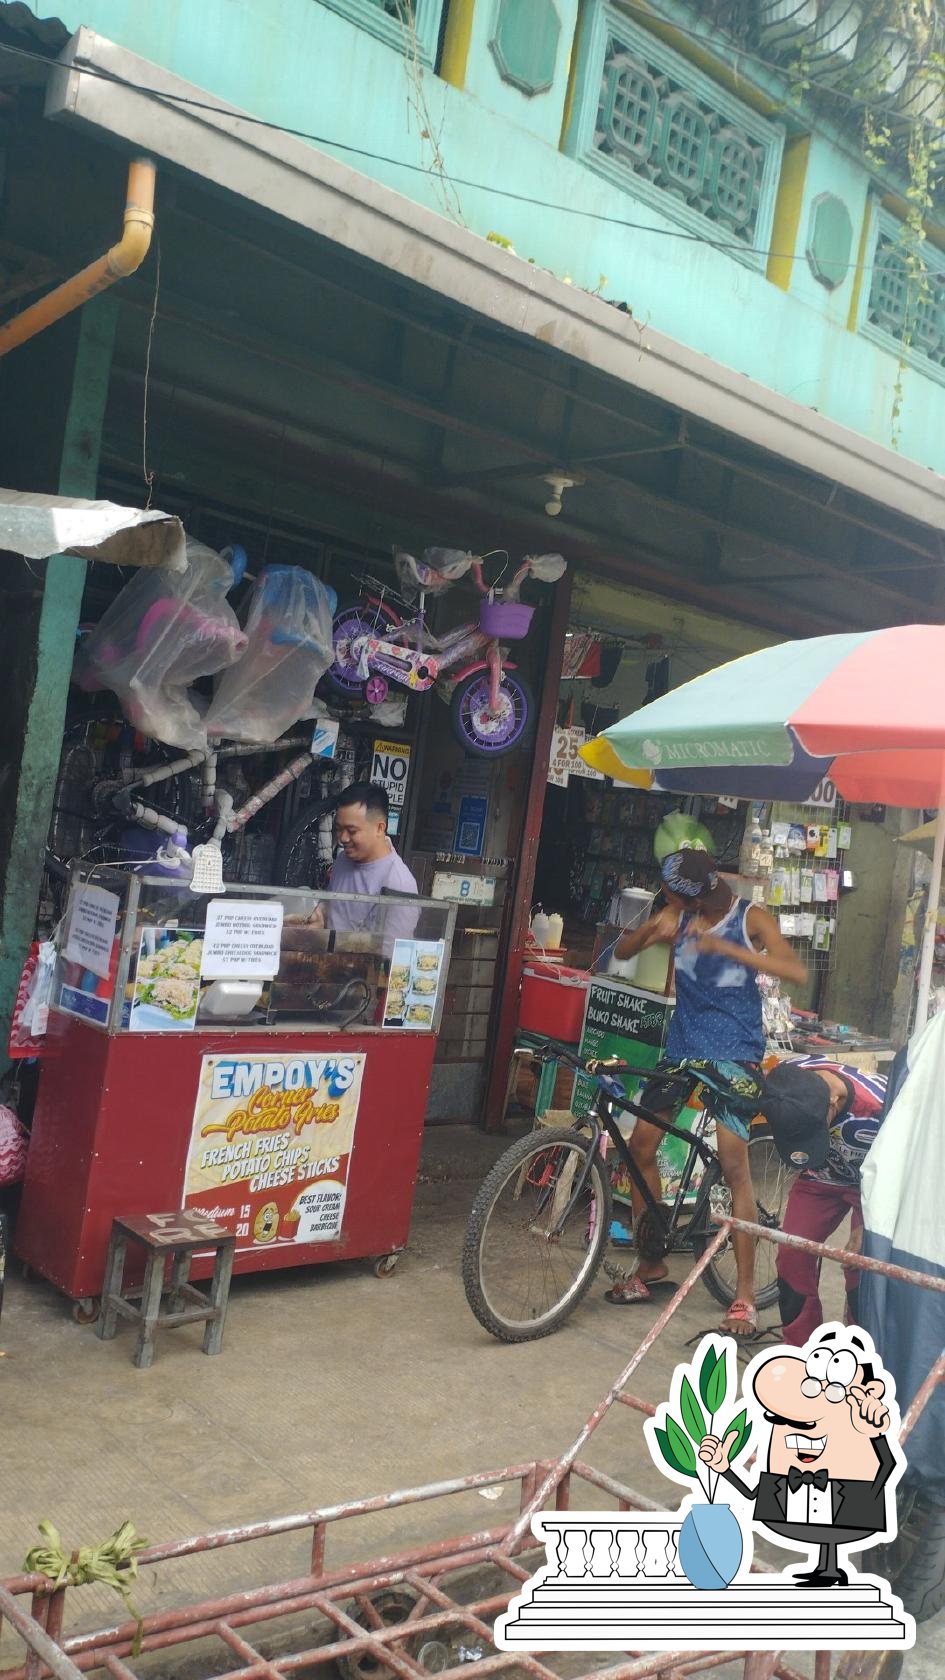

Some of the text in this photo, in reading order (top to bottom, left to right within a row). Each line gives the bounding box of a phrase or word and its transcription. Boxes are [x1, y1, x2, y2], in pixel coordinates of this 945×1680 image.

[384, 745, 410, 755] WARNING
[557, 736, 579, 759] 25
[664, 739, 770, 760] MICROMATIC
[373, 754, 407, 781] NO
[591, 985, 648, 1014] FRUIT SHAKE
[587, 1006, 609, 1024] BUKO
[610, 1013, 640, 1033] SHAKE
[211, 1058, 356, 1099] EMPOY'S
[201, 1106, 292, 1142] Potato
[200, 1132, 290, 1169] FRENCH FRIES
[221, 1145, 311, 1182] POTATO CHIPS
[249, 1156, 340, 1193] CHEESE STICKS
[240, 1204, 251, 1219] 15
[299, 1194, 316, 1205] BEST
[305, 1203, 341, 1214] SOUR CREAM
[320, 1212, 339, 1221] CHEESE
[235, 1223, 249, 1237] 20
